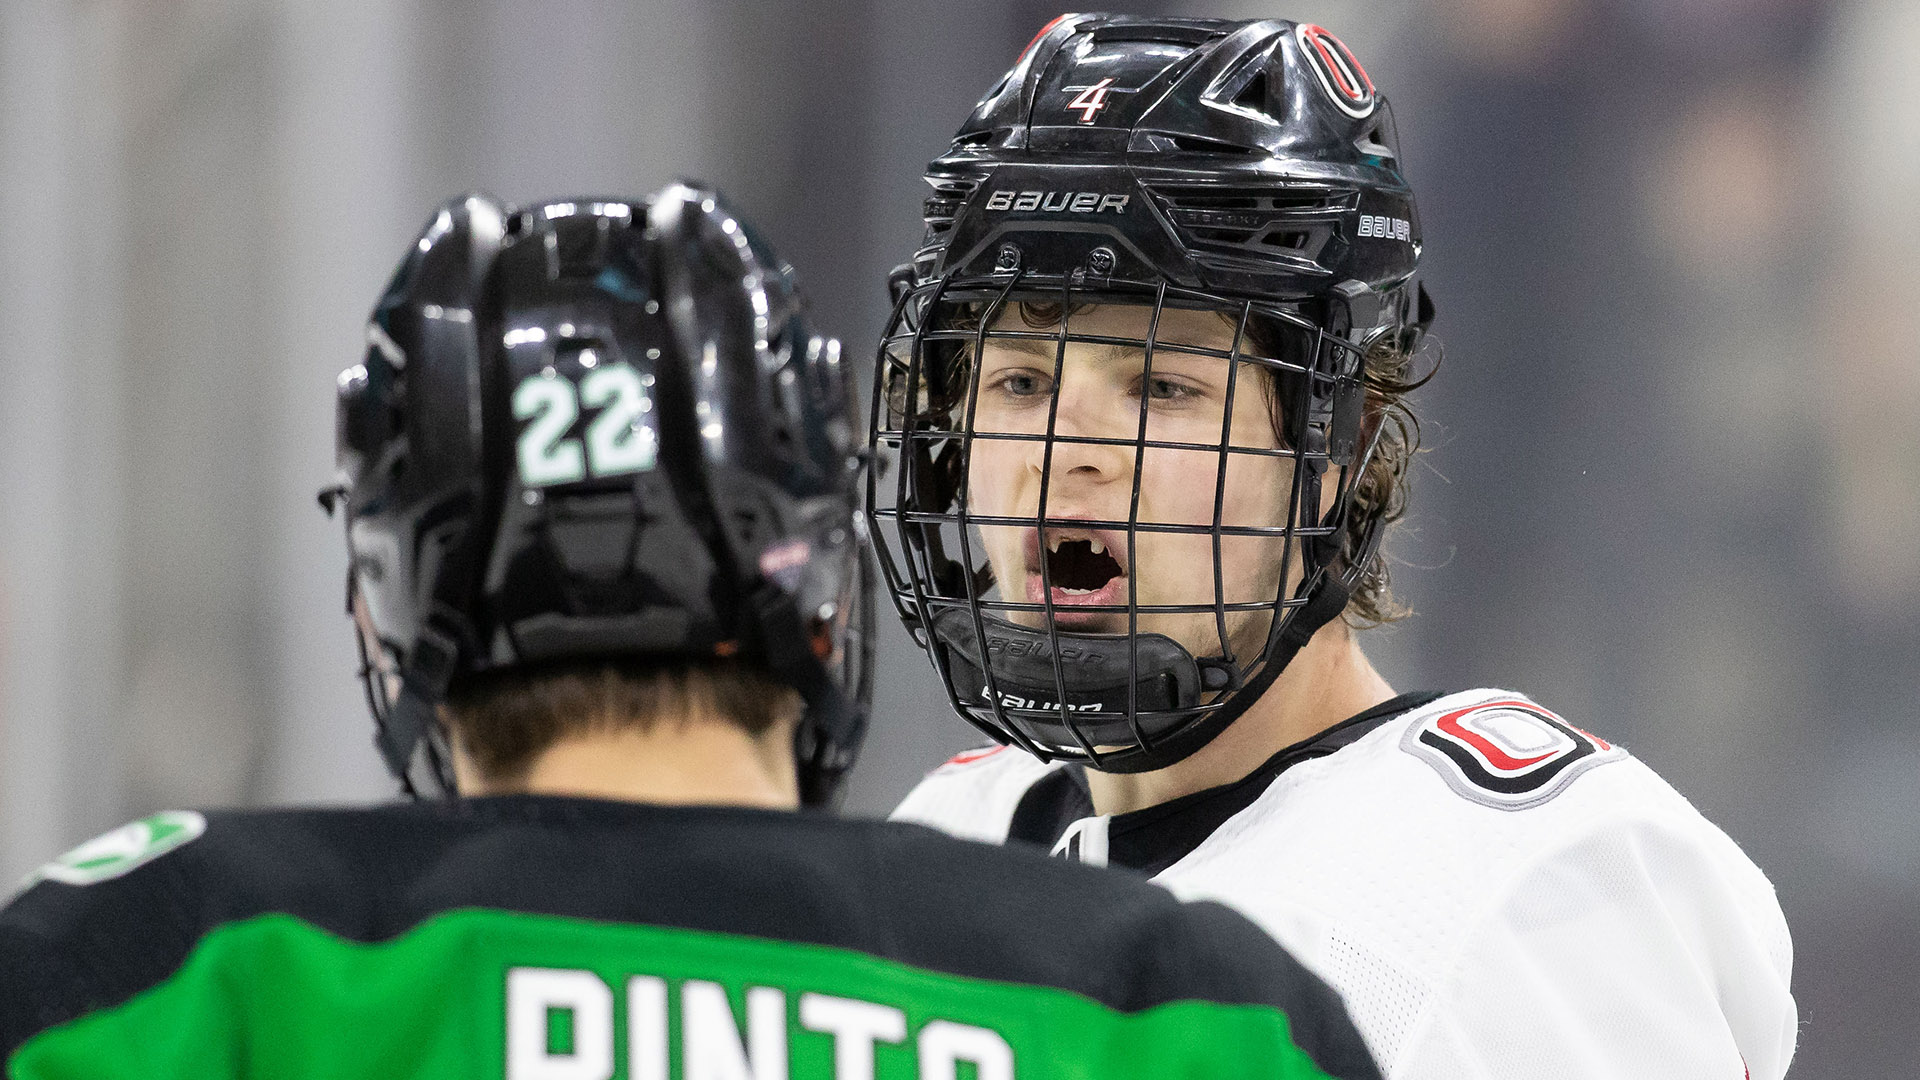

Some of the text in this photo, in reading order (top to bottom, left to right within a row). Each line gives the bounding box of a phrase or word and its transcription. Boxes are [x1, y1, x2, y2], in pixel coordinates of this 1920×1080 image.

[1064, 77, 1120, 125] 4
[985, 190, 1130, 214] BAUER
[1357, 214, 1411, 243] BAUER
[512, 362, 656, 487] 22
